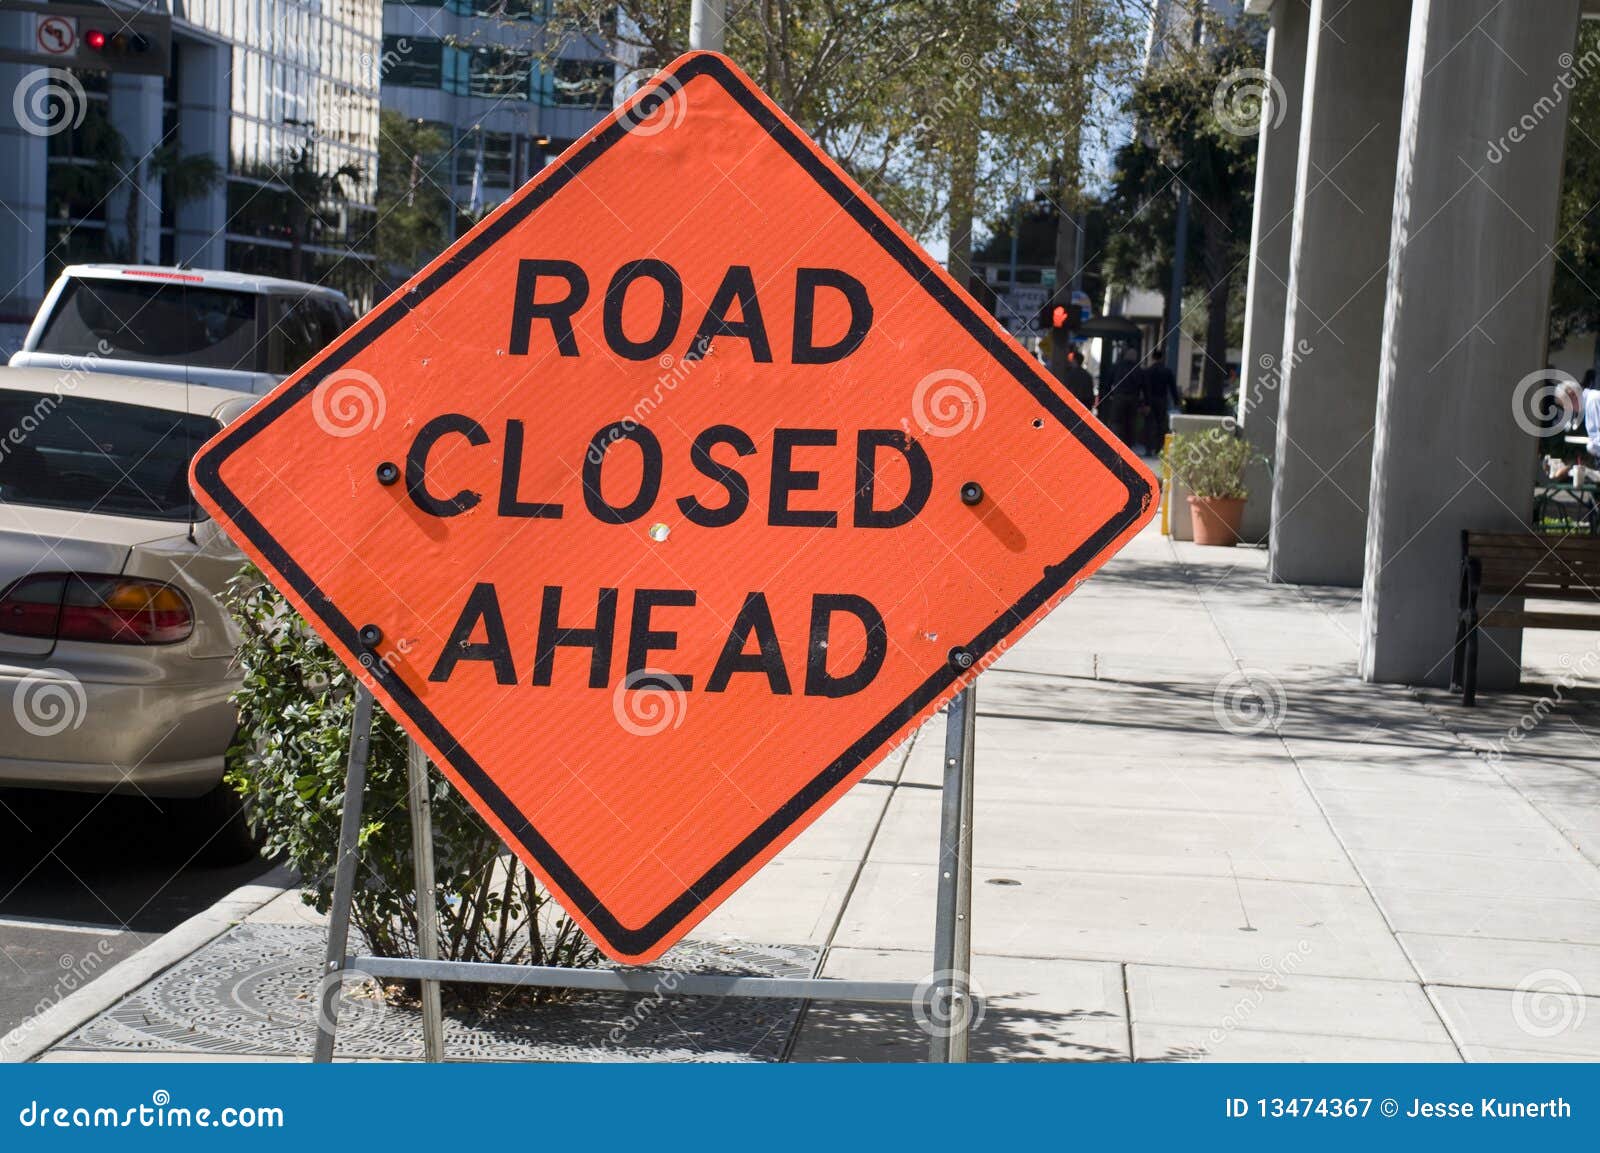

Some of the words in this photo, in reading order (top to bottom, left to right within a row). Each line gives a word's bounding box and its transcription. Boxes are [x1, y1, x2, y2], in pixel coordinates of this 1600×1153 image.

[510, 259, 873, 364] ROAD
[405, 414, 932, 528] CLOSED
[429, 583, 887, 698] AHEAD
